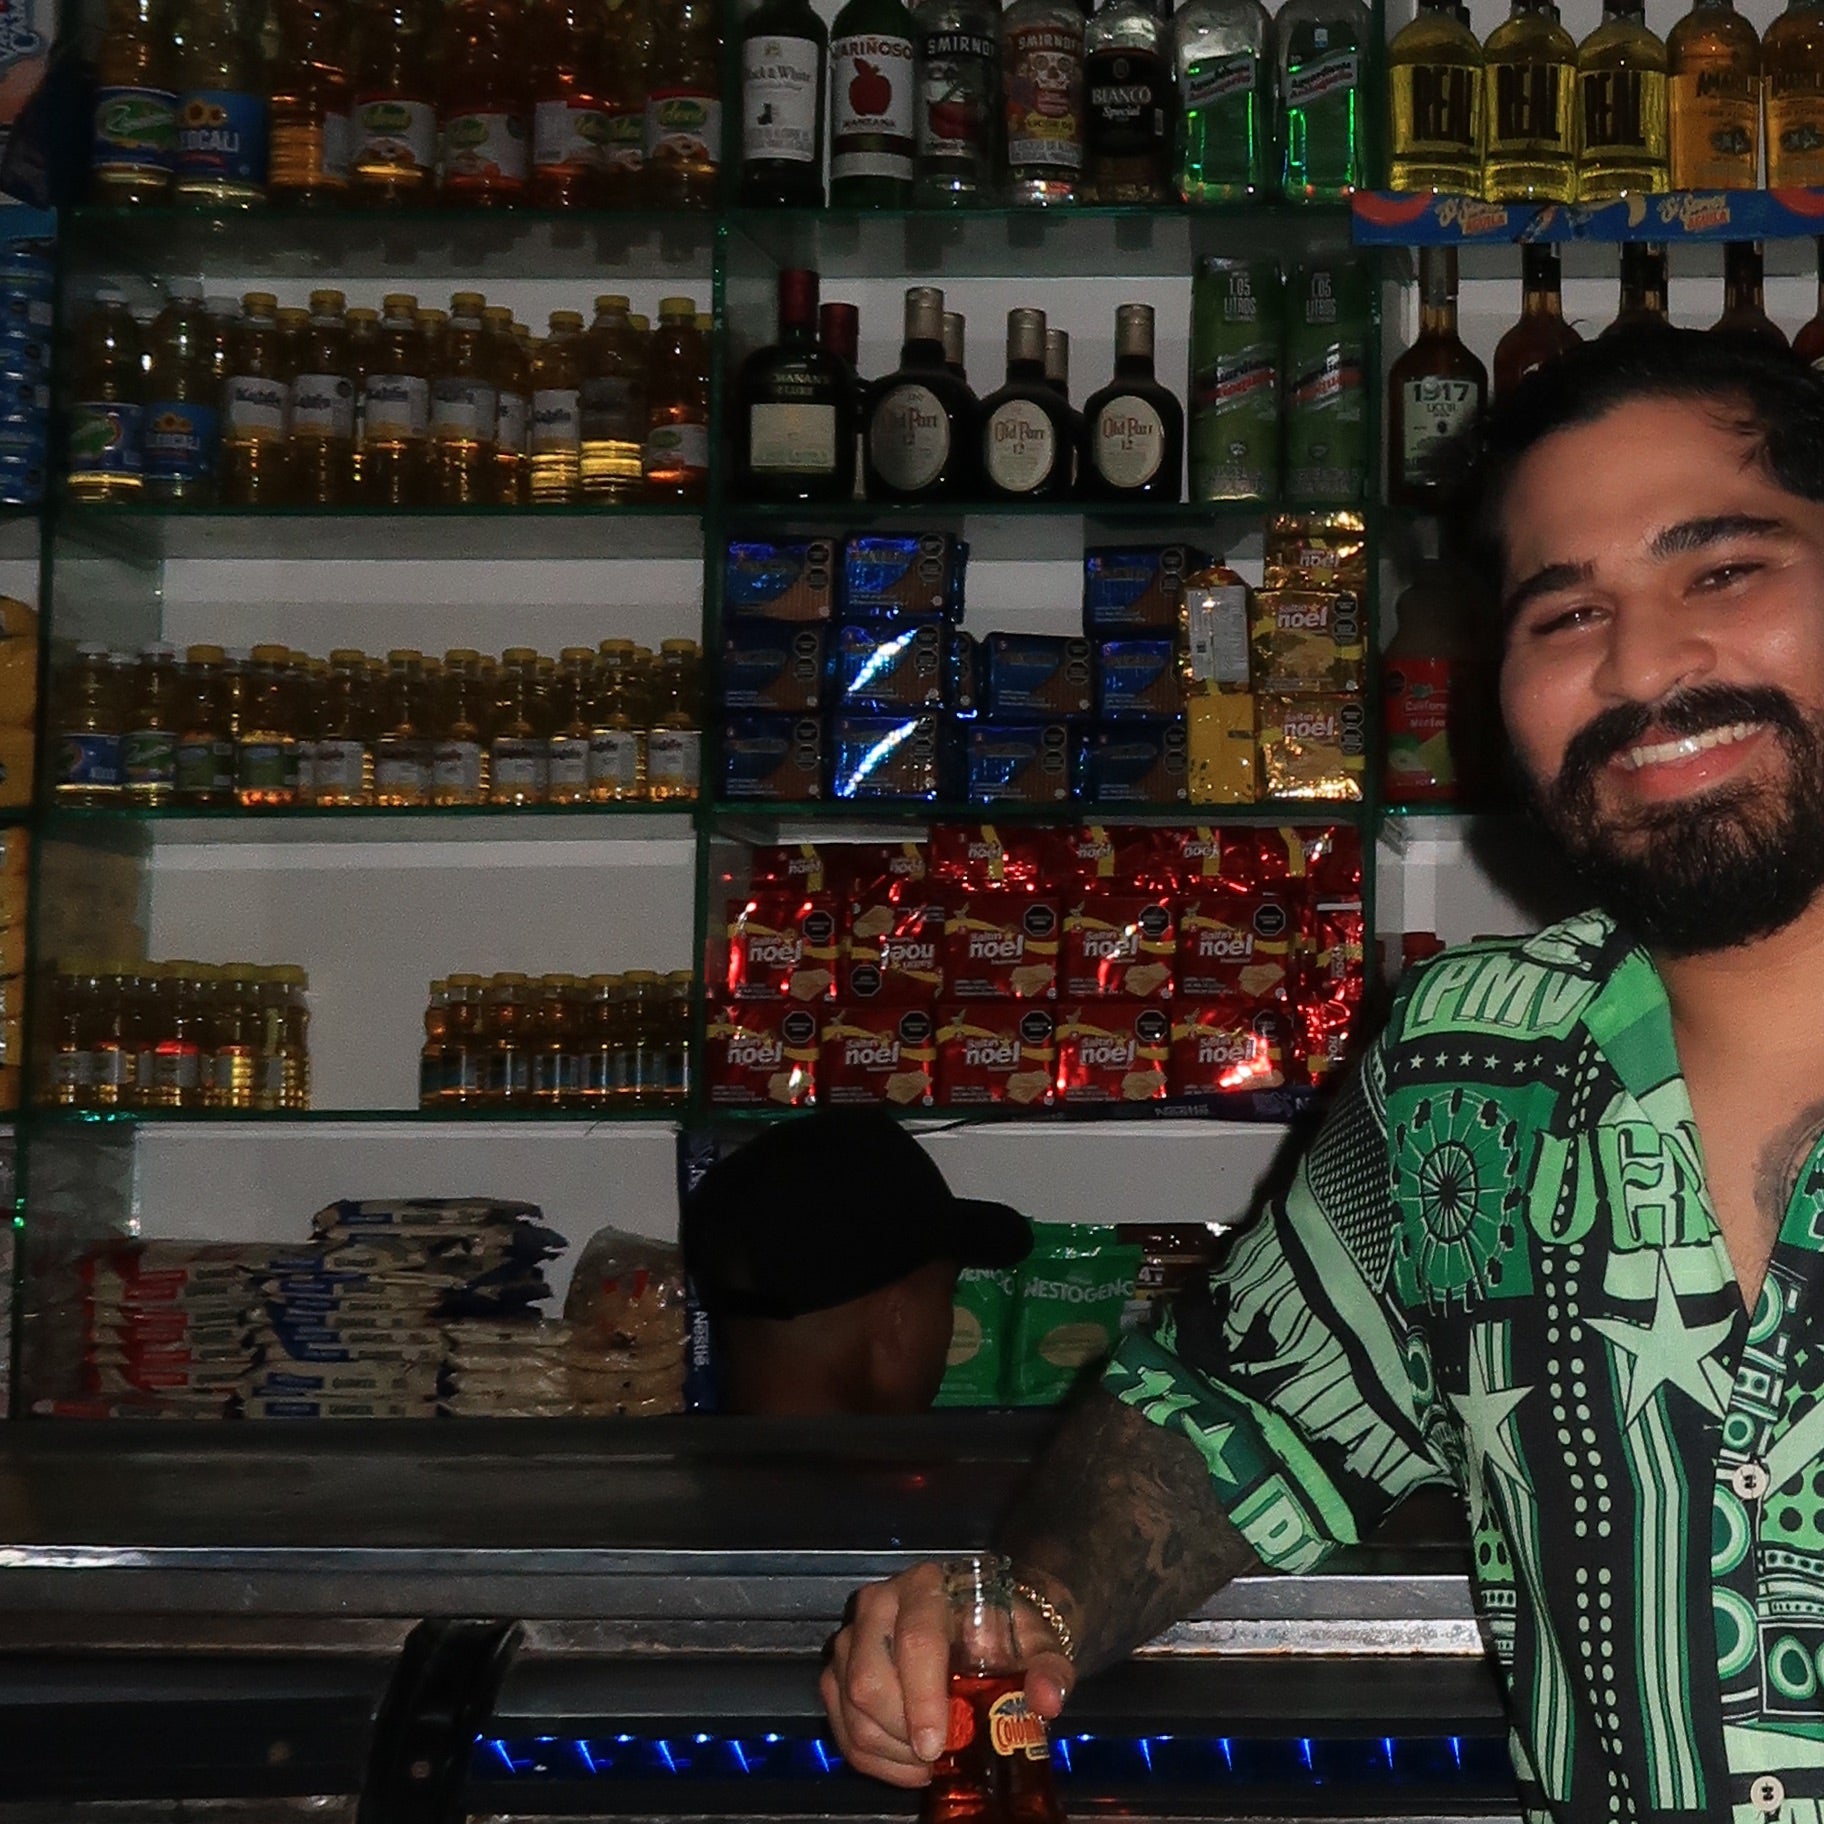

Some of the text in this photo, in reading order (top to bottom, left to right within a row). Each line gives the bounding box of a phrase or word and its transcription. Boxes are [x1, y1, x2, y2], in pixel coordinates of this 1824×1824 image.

[1223, 296, 1257, 315] LITROS
[1412, 378, 1471, 403] 1917
[993, 421, 1019, 443] Old
[1102, 416, 1127, 439] Old
[1277, 608, 1329, 628] noel
[1283, 716, 1335, 737] noel
[750, 939, 803, 962] noel
[969, 936, 1024, 960] noel
[1082, 933, 1139, 958] noel
[1200, 933, 1254, 957] noel
[727, 1041, 783, 1065] noel
[844, 1041, 901, 1066] noel
[964, 1041, 1021, 1066] noel
[1079, 1038, 1136, 1064] noel
[1199, 1038, 1256, 1064] noel
